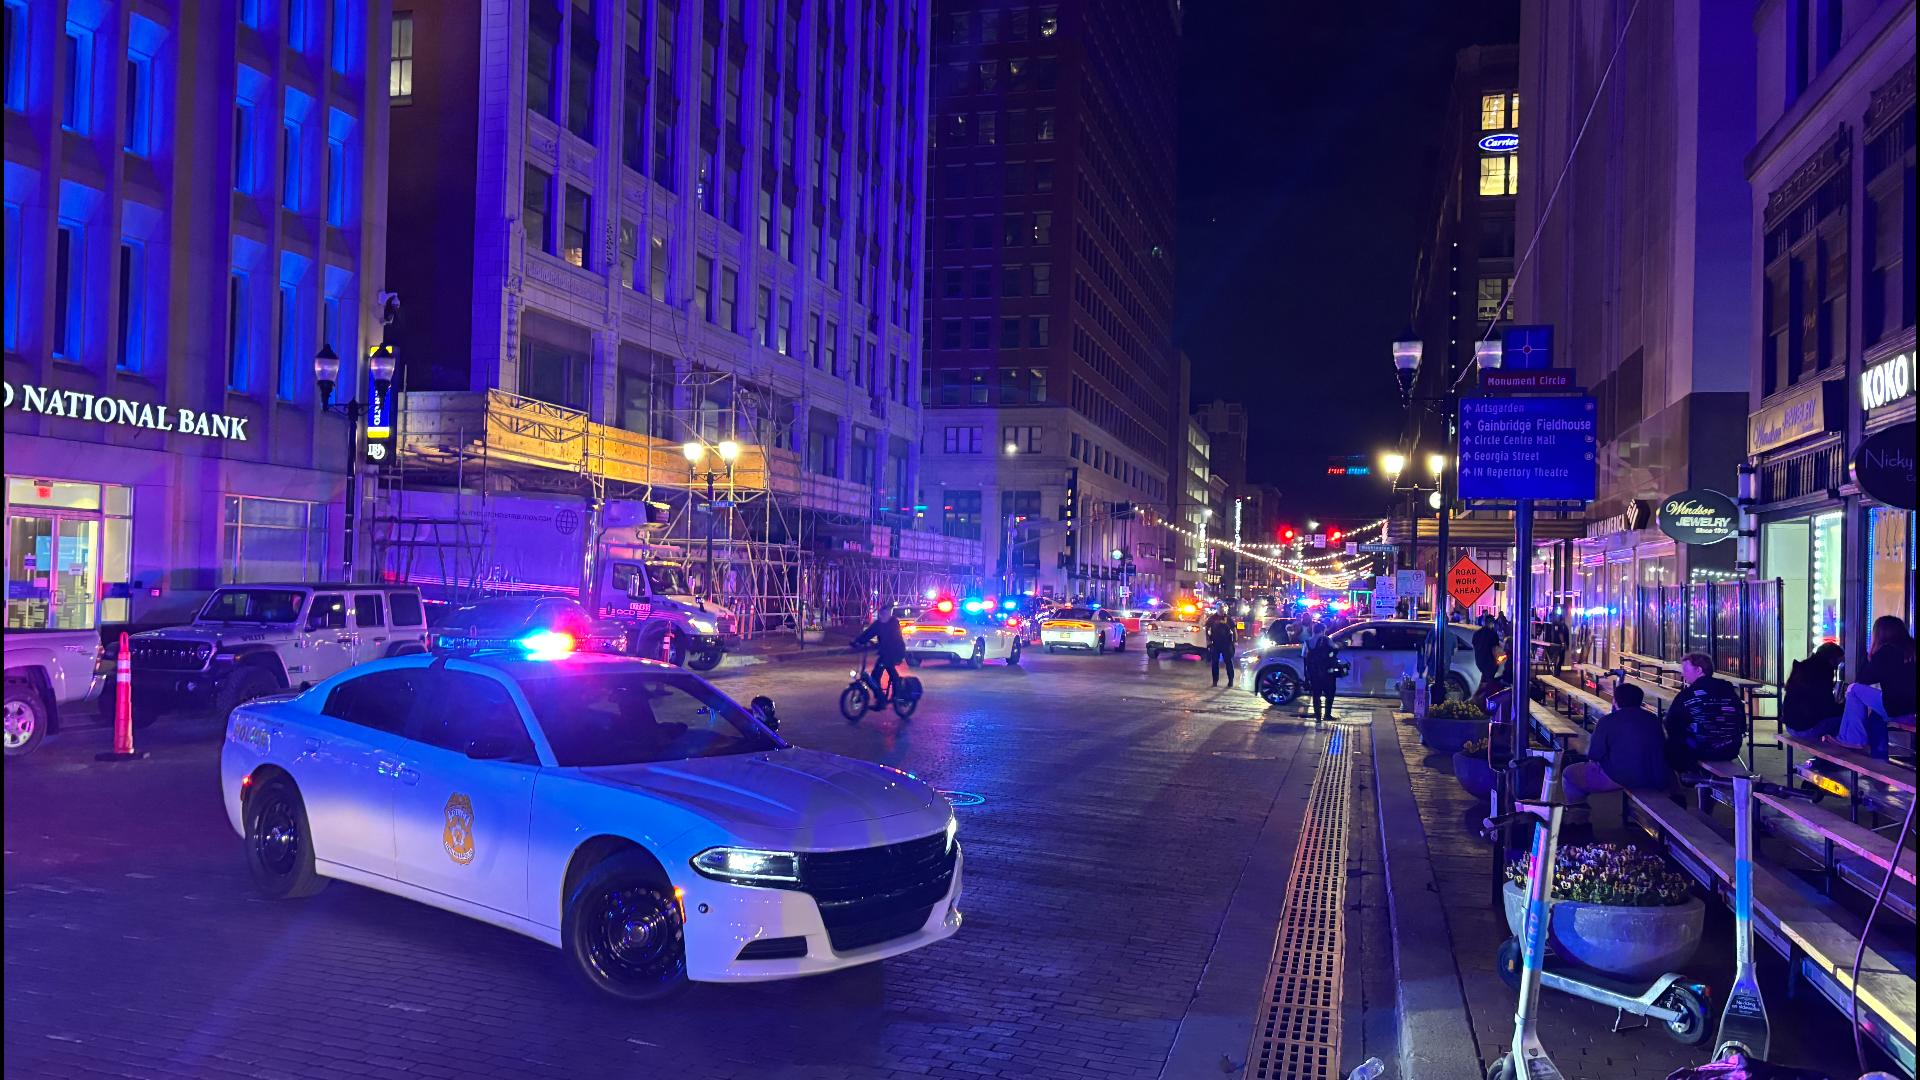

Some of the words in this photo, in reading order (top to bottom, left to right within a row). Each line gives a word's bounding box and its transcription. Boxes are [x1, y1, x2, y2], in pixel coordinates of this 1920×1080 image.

[1487, 376, 1536, 386] Monument
[1539, 376, 1567, 385] Circle
[1861, 354, 1909, 411] KOKO
[22, 384, 173, 432] NATIONAL
[178, 408, 249, 441] BANK
[1474, 403, 1525, 415] Artsgarden
[1477, 419, 1532, 434] Gainbridge
[1536, 418, 1591, 431] Fieldhouse
[1474, 435, 1501, 445] Circle
[1503, 435, 1533, 445] Centre
[1536, 435, 1556, 445] Mall
[1474, 451, 1509, 463] Georgia
[1512, 451, 1540, 461] Street
[1865, 448, 1914, 471] Nicky
[1473, 467, 1484, 477] IN
[1487, 467, 1531, 479] Repertory
[1534, 467, 1569, 477] Theatre
[1665, 500, 1716, 515] Windsor
[1675, 516, 1732, 528] JEWELRY
[1455, 568, 1477, 576] ROAD
